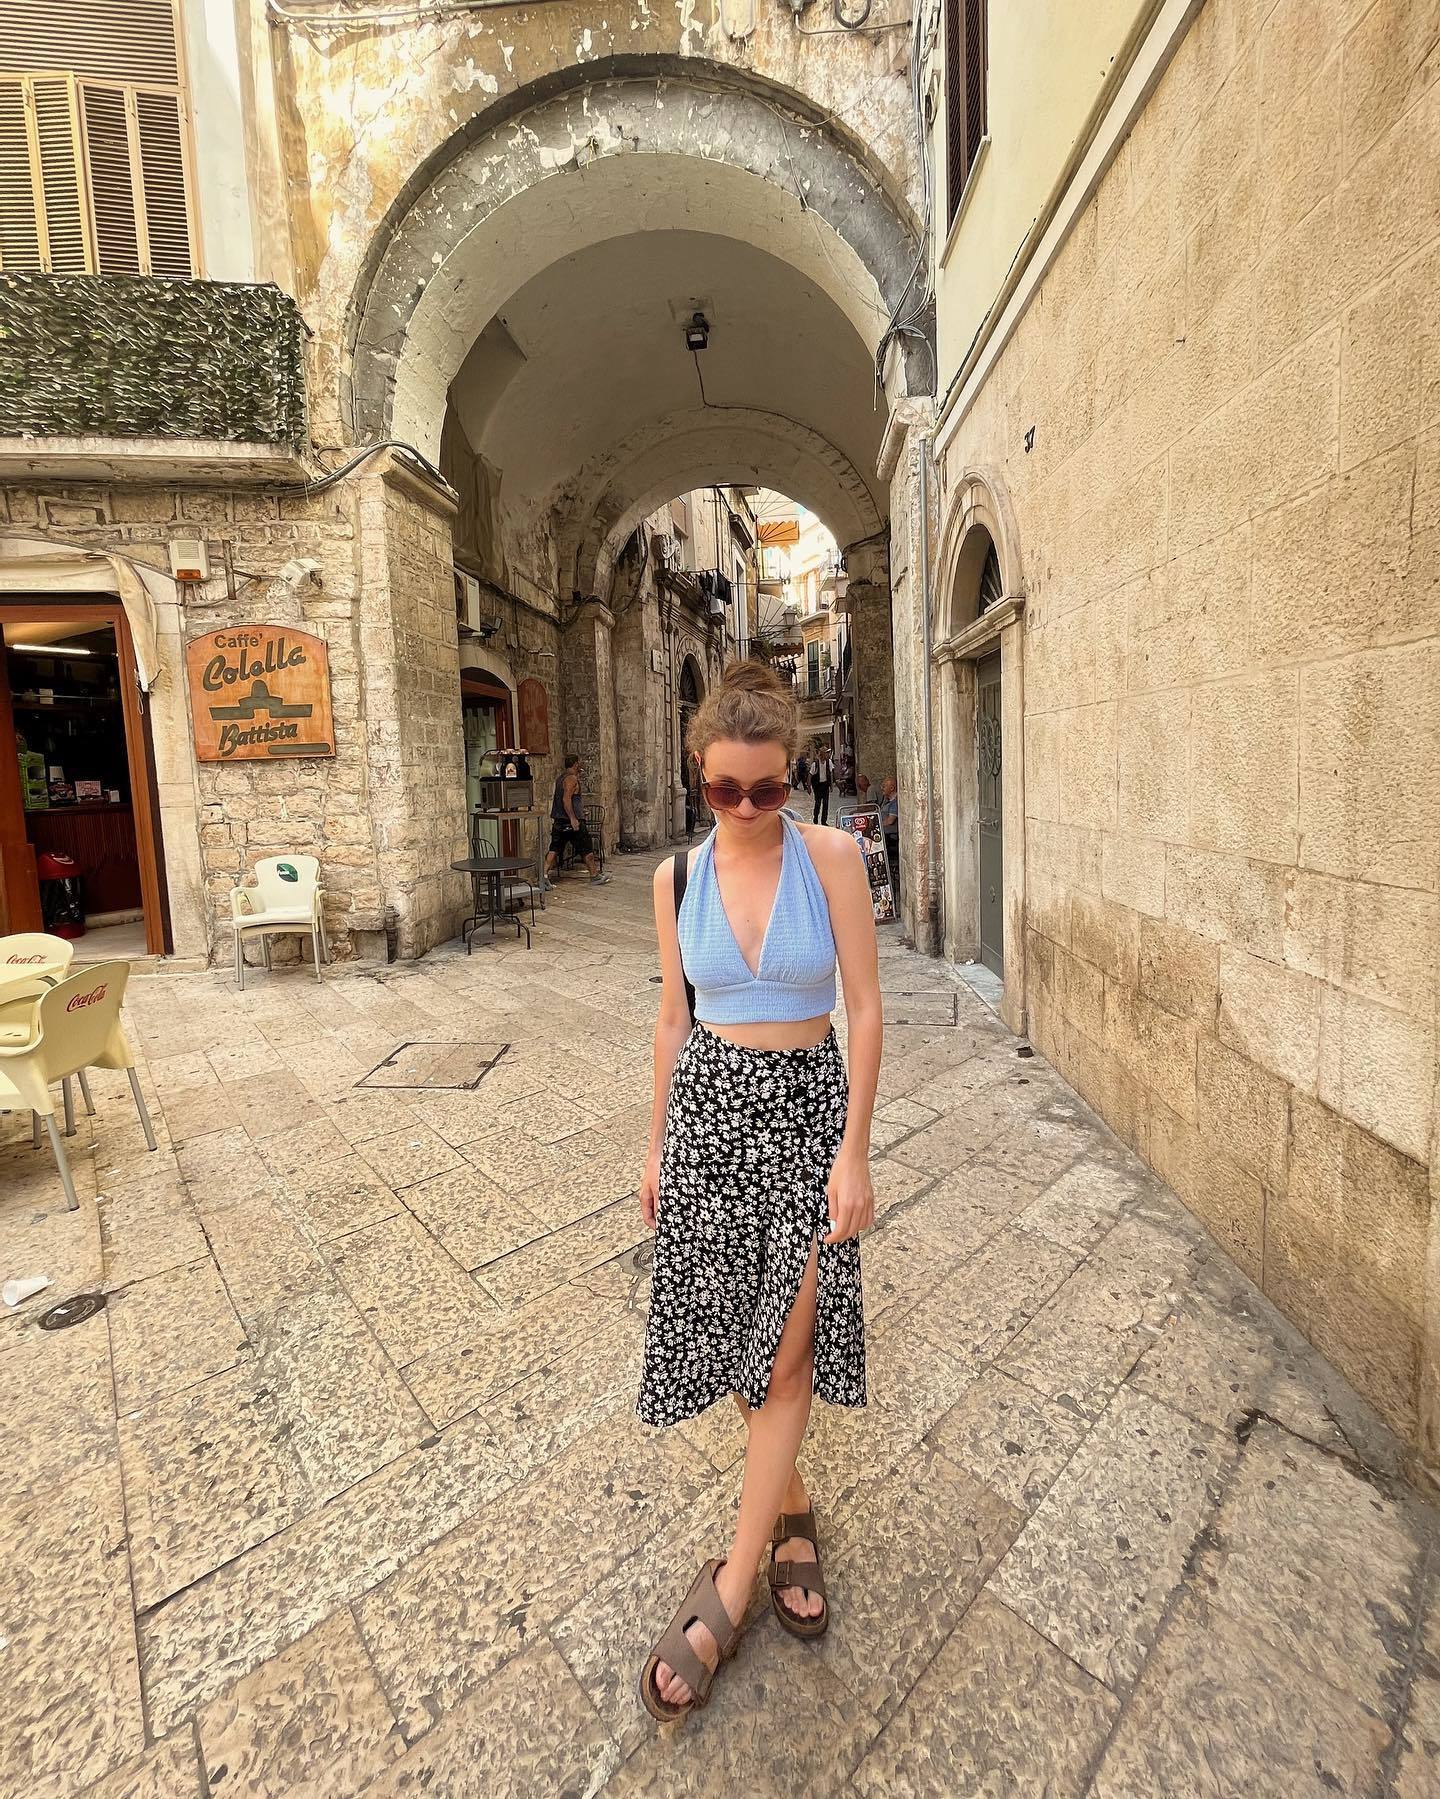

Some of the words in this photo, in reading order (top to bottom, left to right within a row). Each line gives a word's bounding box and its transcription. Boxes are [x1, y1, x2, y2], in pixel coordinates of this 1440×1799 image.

[1024, 425, 1035, 453] 37
[202, 637, 307, 692] Colella
[218, 722, 298, 757] Battista
